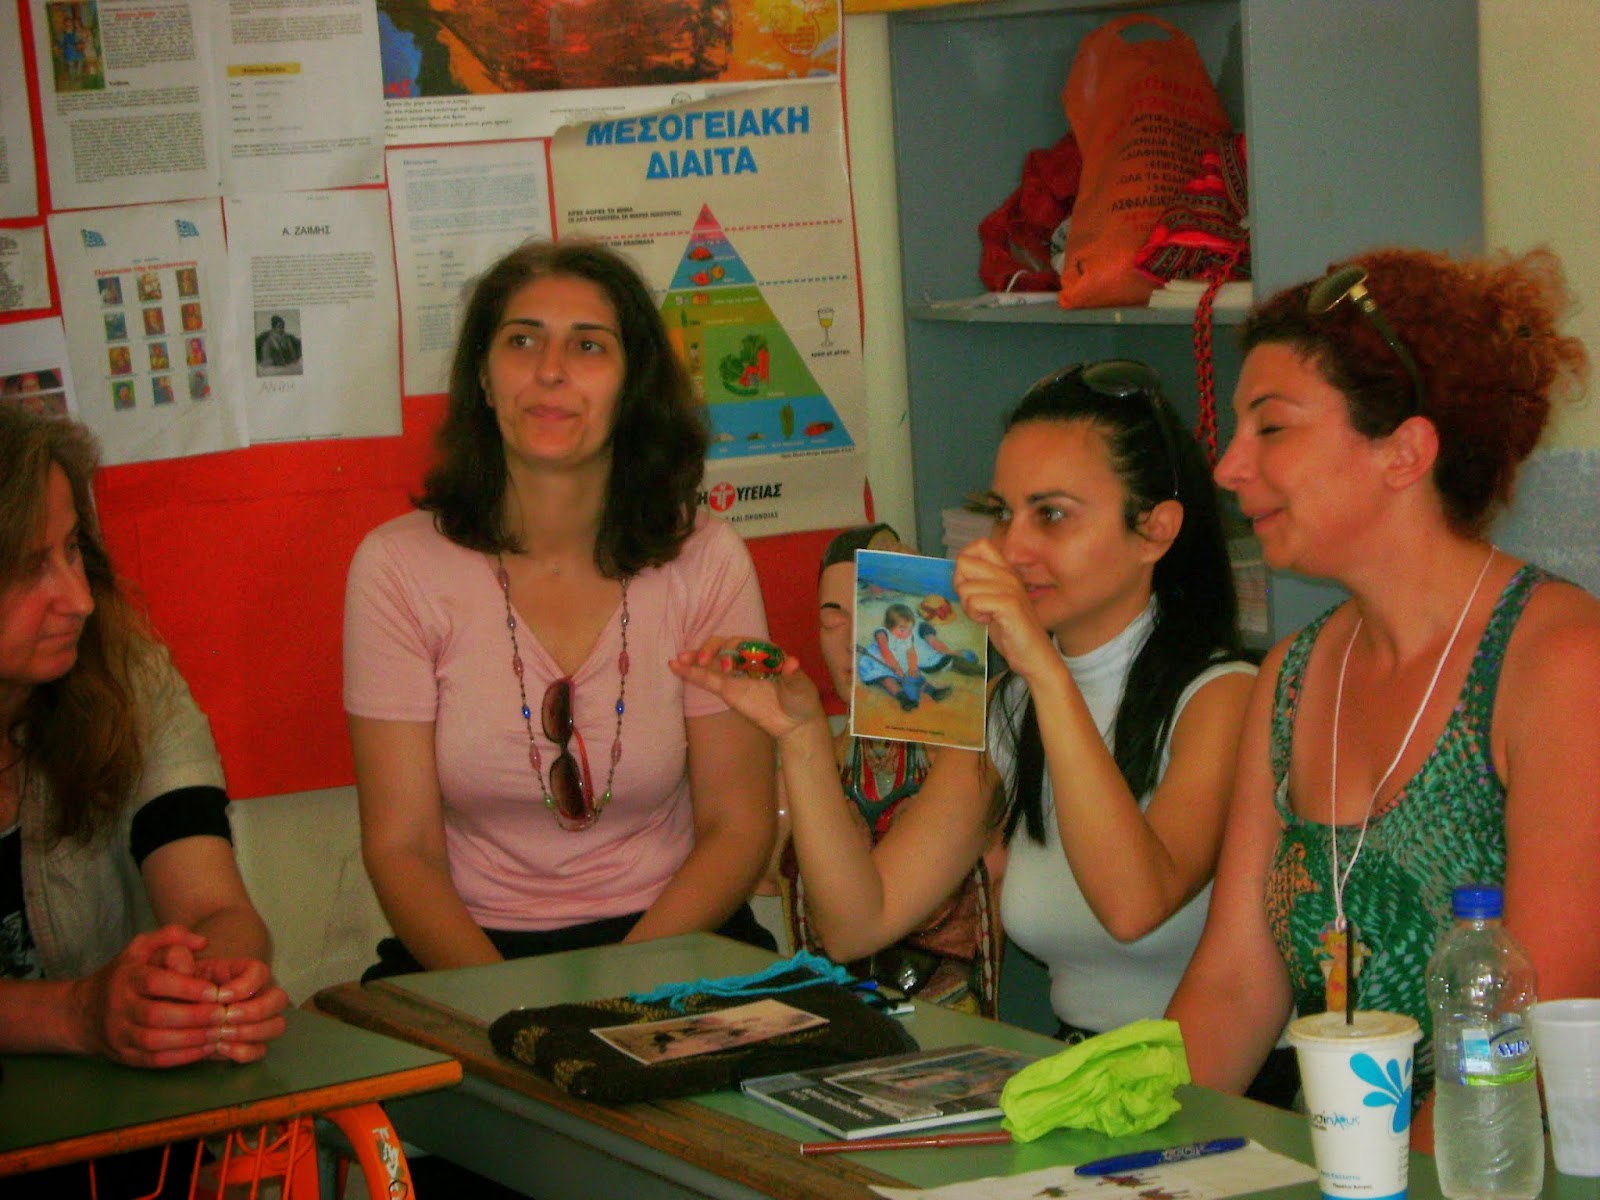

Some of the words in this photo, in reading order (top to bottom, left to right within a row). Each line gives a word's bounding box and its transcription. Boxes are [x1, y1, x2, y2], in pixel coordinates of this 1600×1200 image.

[586, 105, 810, 146] ΜΕΣΟΓΕΙΑΚΗ
[646, 146, 758, 180] ΔΙΑΙΤΑ
[736, 482, 783, 502] ΥΓΕΙΑΣ
